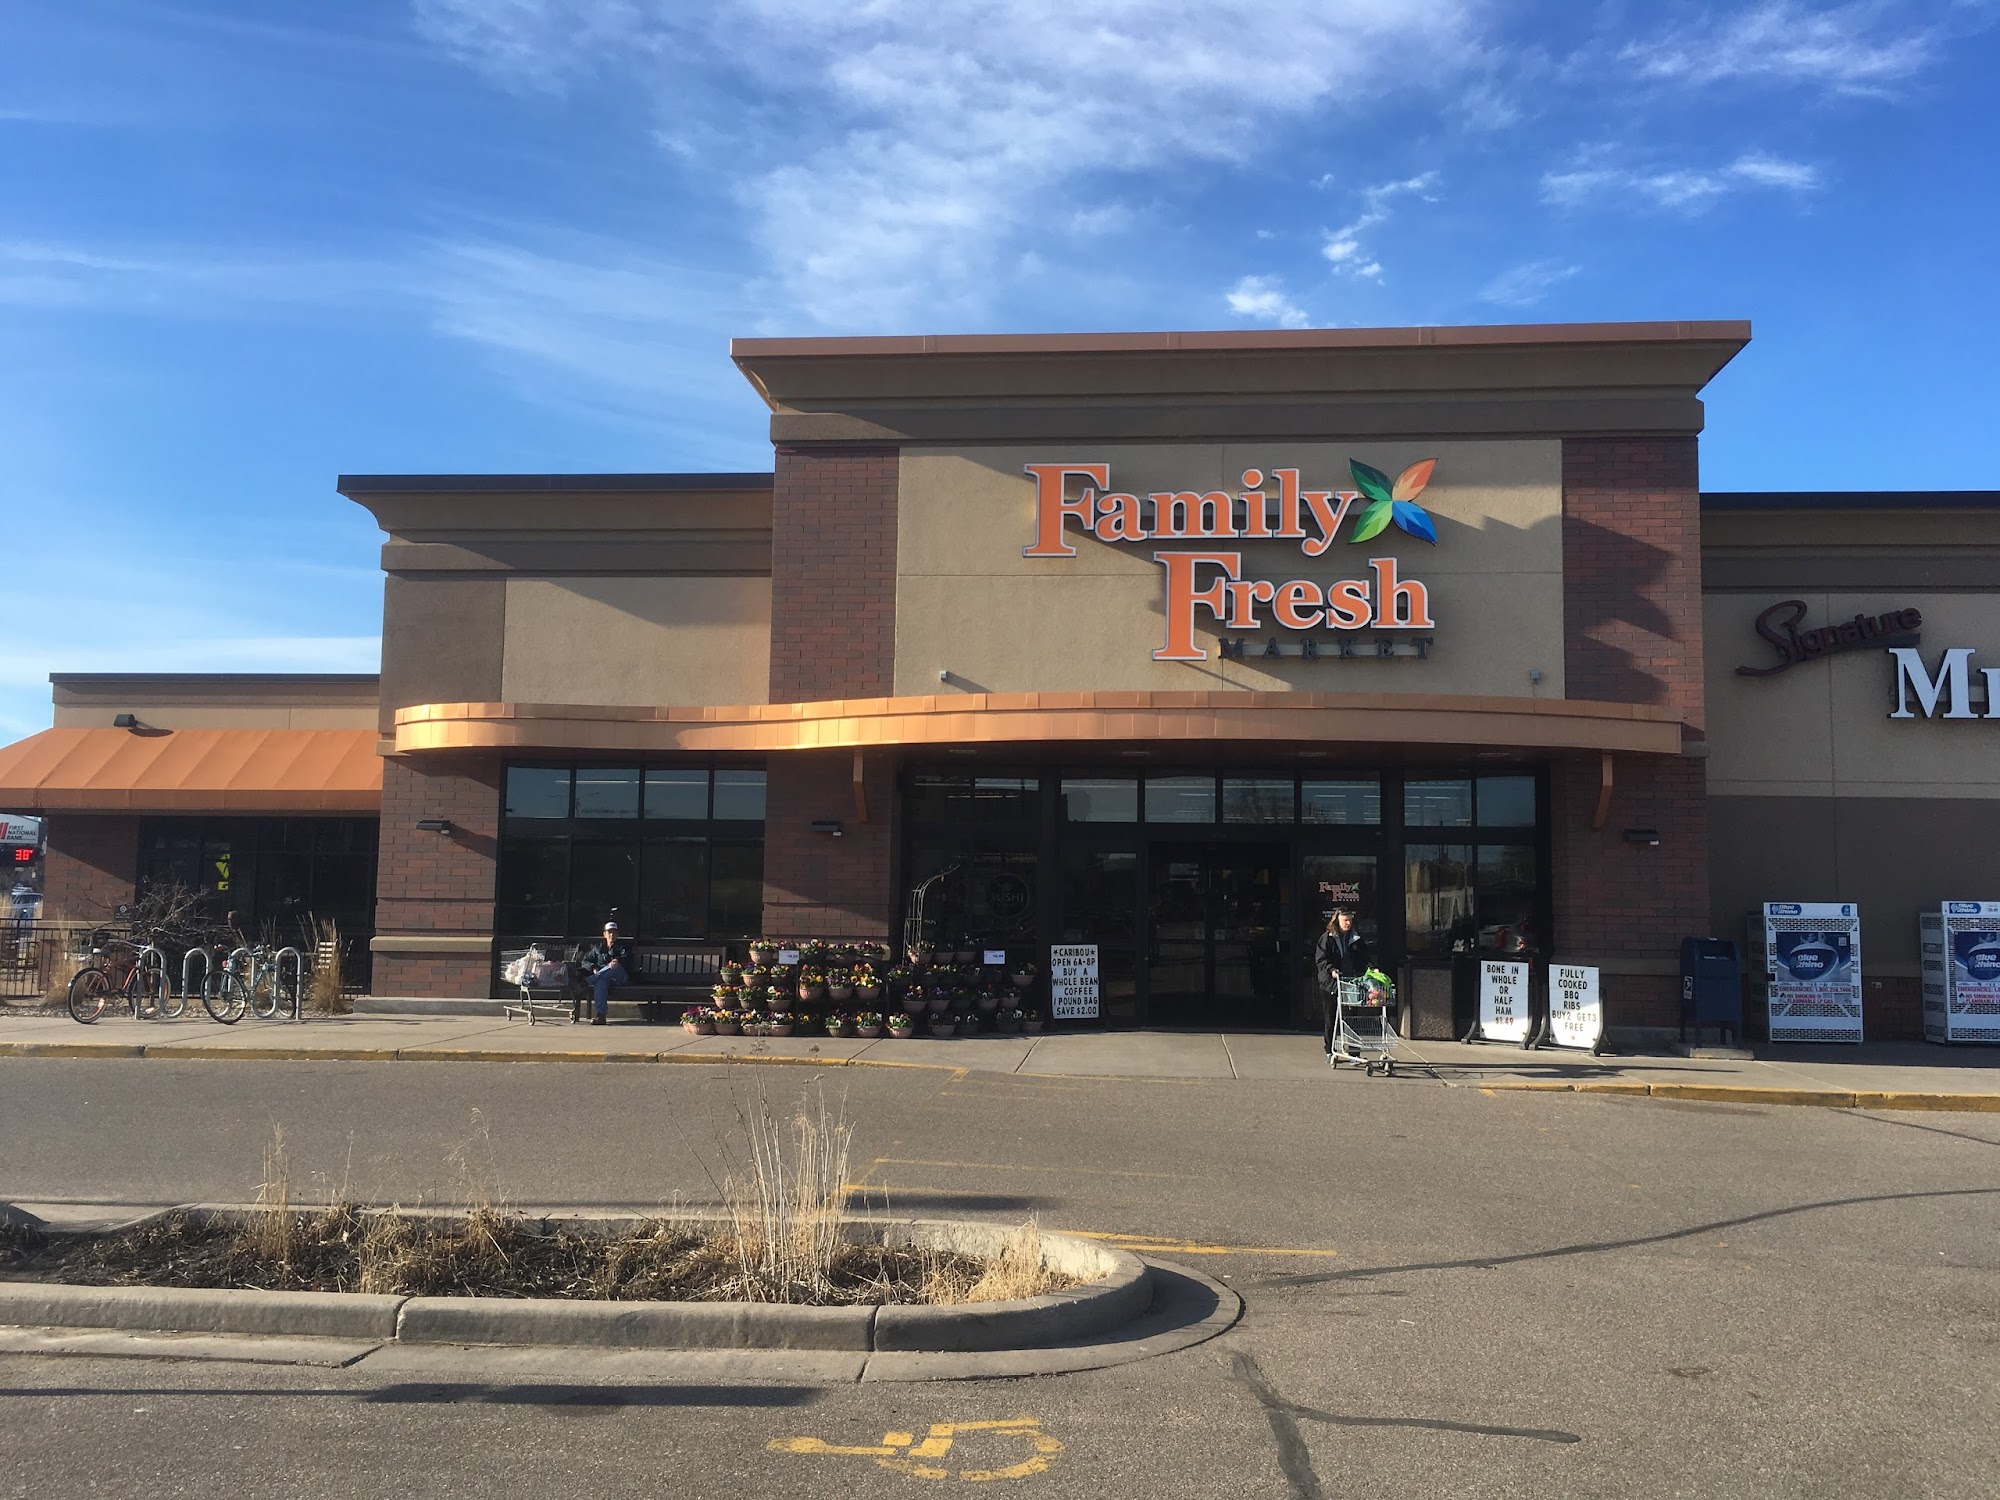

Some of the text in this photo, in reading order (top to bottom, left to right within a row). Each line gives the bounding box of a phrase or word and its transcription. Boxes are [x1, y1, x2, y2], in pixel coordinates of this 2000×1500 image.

[1022, 462, 1359, 557] Family
[1152, 550, 1435, 661] Fresh
[1735, 600, 1922, 676] Signature
[1218, 637, 1434, 659] MARKET
[1060, 948, 1090, 957] CARIBOU
[1052, 958, 1096, 967] OPEN 6A-8P
[1063, 968, 1088, 976] BUY A
[1486, 964, 1519, 975] BONE IN
[1560, 968, 1585, 979] FULLY
[1052, 978, 1098, 986] WHOLE BEAN
[1491, 974, 1517, 985] WHOLE
[1558, 979, 1588, 990] COOKED
[1064, 987, 1093, 995] COFFEE
[1499, 986, 1509, 995] OR
[1564, 990, 1579, 1000] BBQ
[1058, 997, 1082, 1005] POUND
[1083, 997, 1098, 1005] BAG
[1494, 996, 1513, 1006] HALF
[1563, 1001, 1581, 1011] RIBS
[1056, 1006, 1097, 1016] SAVE $2.00
[1495, 1006, 1512, 1016] HAM
[1495, 1017, 1514, 1026] $1.49
[1564, 1022, 1584, 1032] FREE
